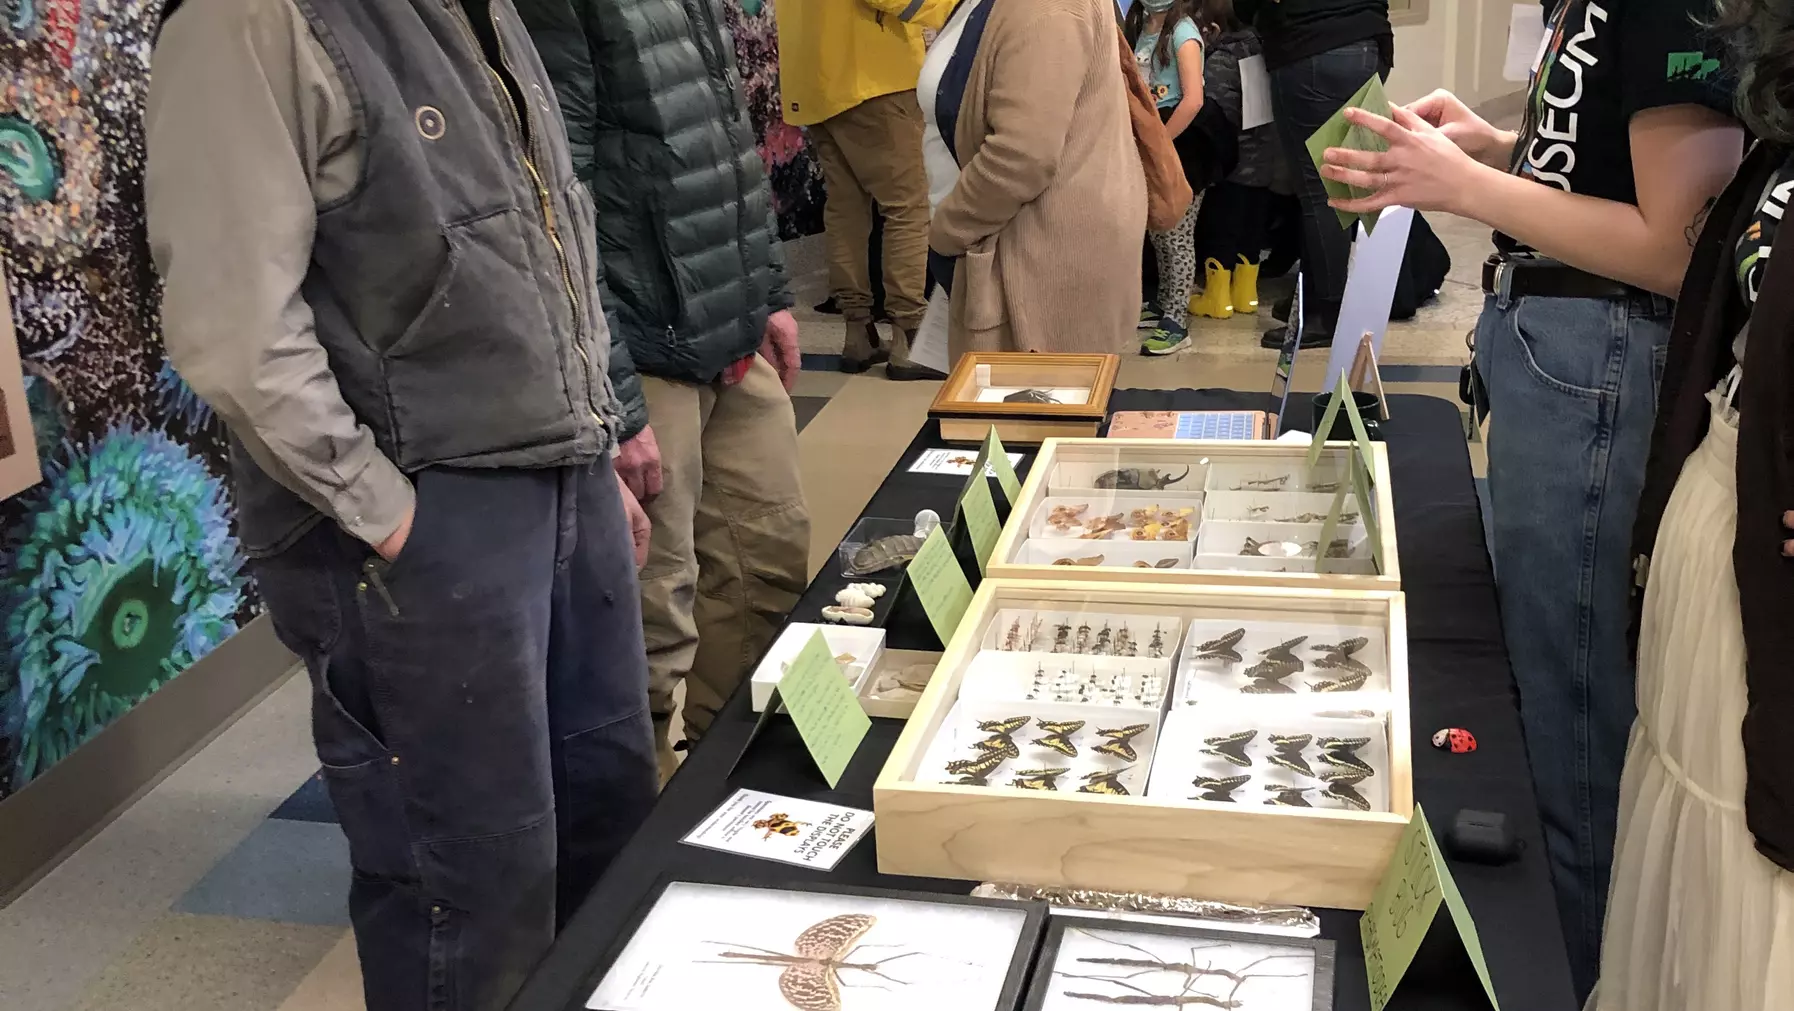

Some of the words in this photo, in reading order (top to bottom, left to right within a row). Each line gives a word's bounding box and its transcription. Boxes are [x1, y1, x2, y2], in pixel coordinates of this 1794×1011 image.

[822, 813, 839, 826] THE
[840, 811, 855, 822] DO
[826, 823, 845, 837] NOT
[829, 827, 856, 850] PLEASE
[794, 826, 826, 854] DISPLAYS
[803, 838, 831, 861] TOUCH
